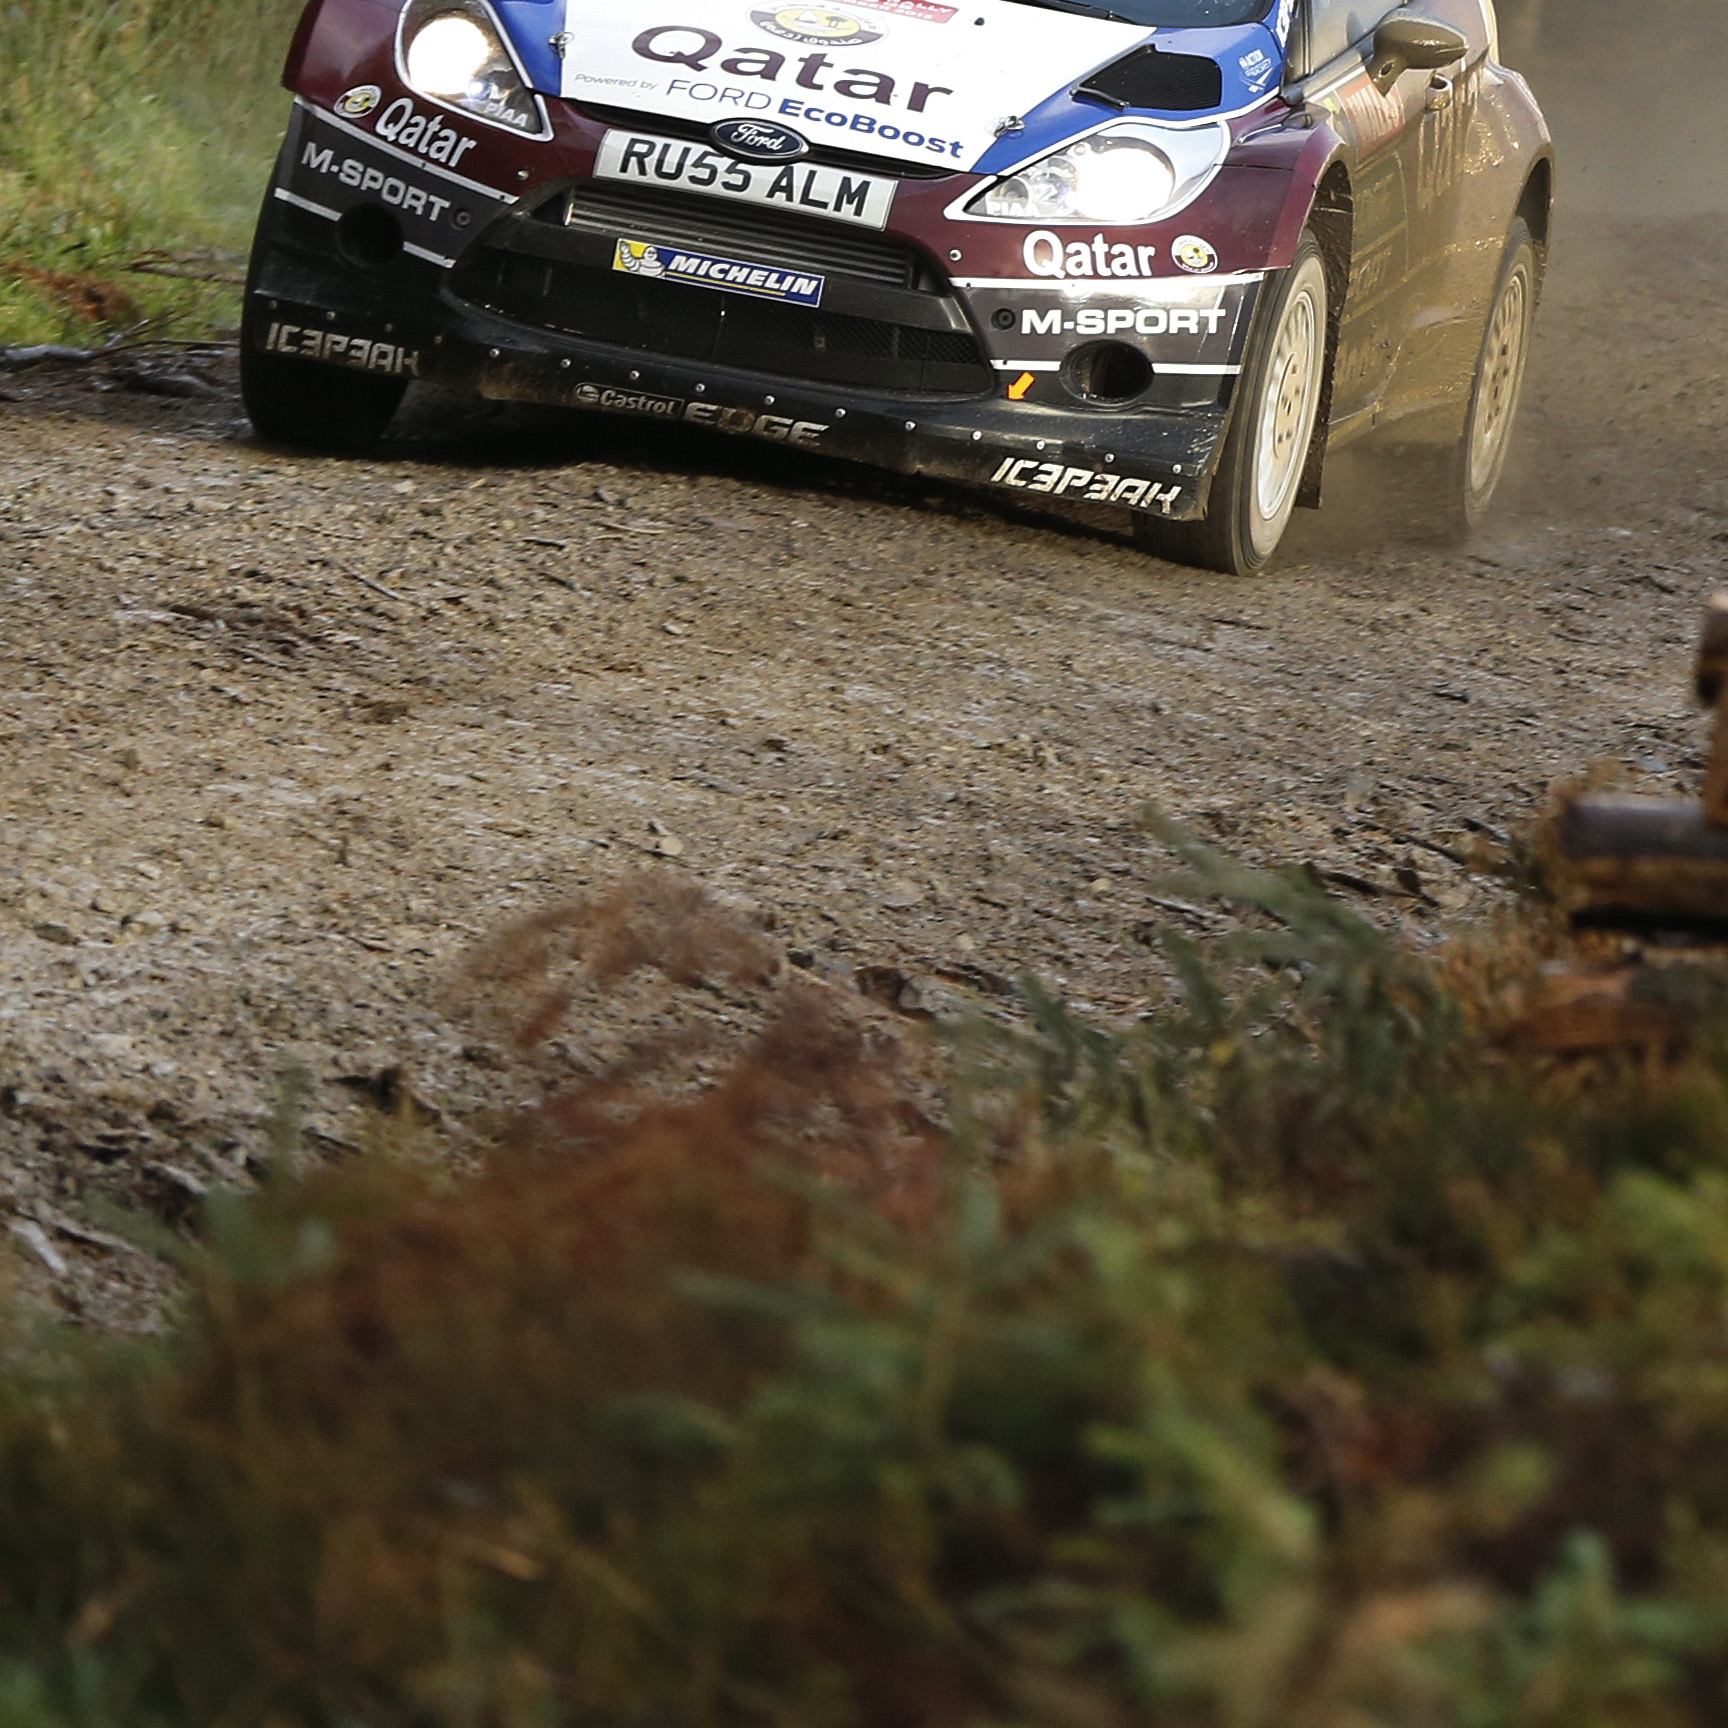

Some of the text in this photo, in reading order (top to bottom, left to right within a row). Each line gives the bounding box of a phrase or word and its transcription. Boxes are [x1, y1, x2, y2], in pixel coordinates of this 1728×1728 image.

[631, 25, 955, 113] Qatar
[375, 97, 477, 168] Qatar
[486, 102, 529, 128] PIAA
[574, 73, 964, 159] Powered by FORD EcoBoost
[731, 122, 787, 151] Ford
[301, 142, 451, 222] M-SPORT
[619, 137, 872, 218] RU55 ALM
[986, 201, 1042, 218] PIAA
[669, 255, 819, 296] MICHELIN
[1023, 230, 1156, 279] Qatar
[1021, 309, 1226, 335] M-SPORT
[601, 390, 830, 447] Castrol EDGE
